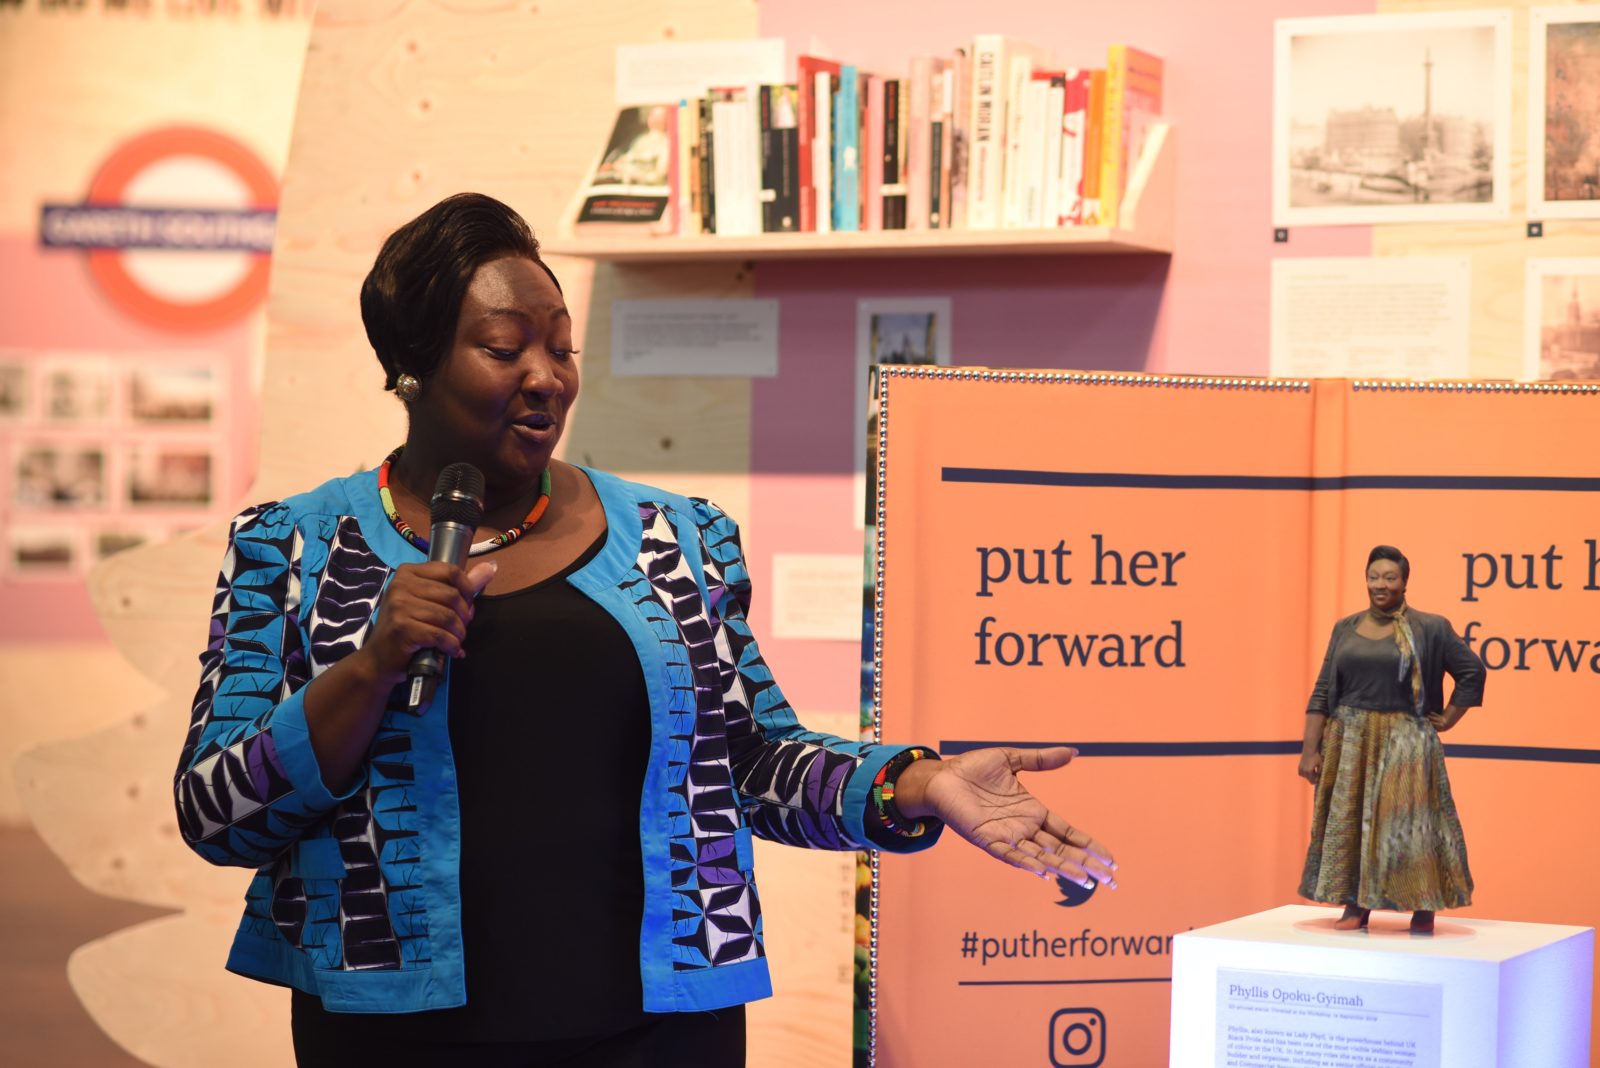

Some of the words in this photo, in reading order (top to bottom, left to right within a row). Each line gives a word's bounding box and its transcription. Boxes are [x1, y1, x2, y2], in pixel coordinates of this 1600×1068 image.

[976, 540, 1071, 597] put
[1091, 534, 1186, 587] her
[1461, 544, 1563, 602] put
[974, 616, 1186, 668] forward
[961, 928, 1193, 966] #putherforwar
[1229, 984, 1269, 999] Phyllis
[1272, 987, 1363, 1007] Opoku-Gyimah
